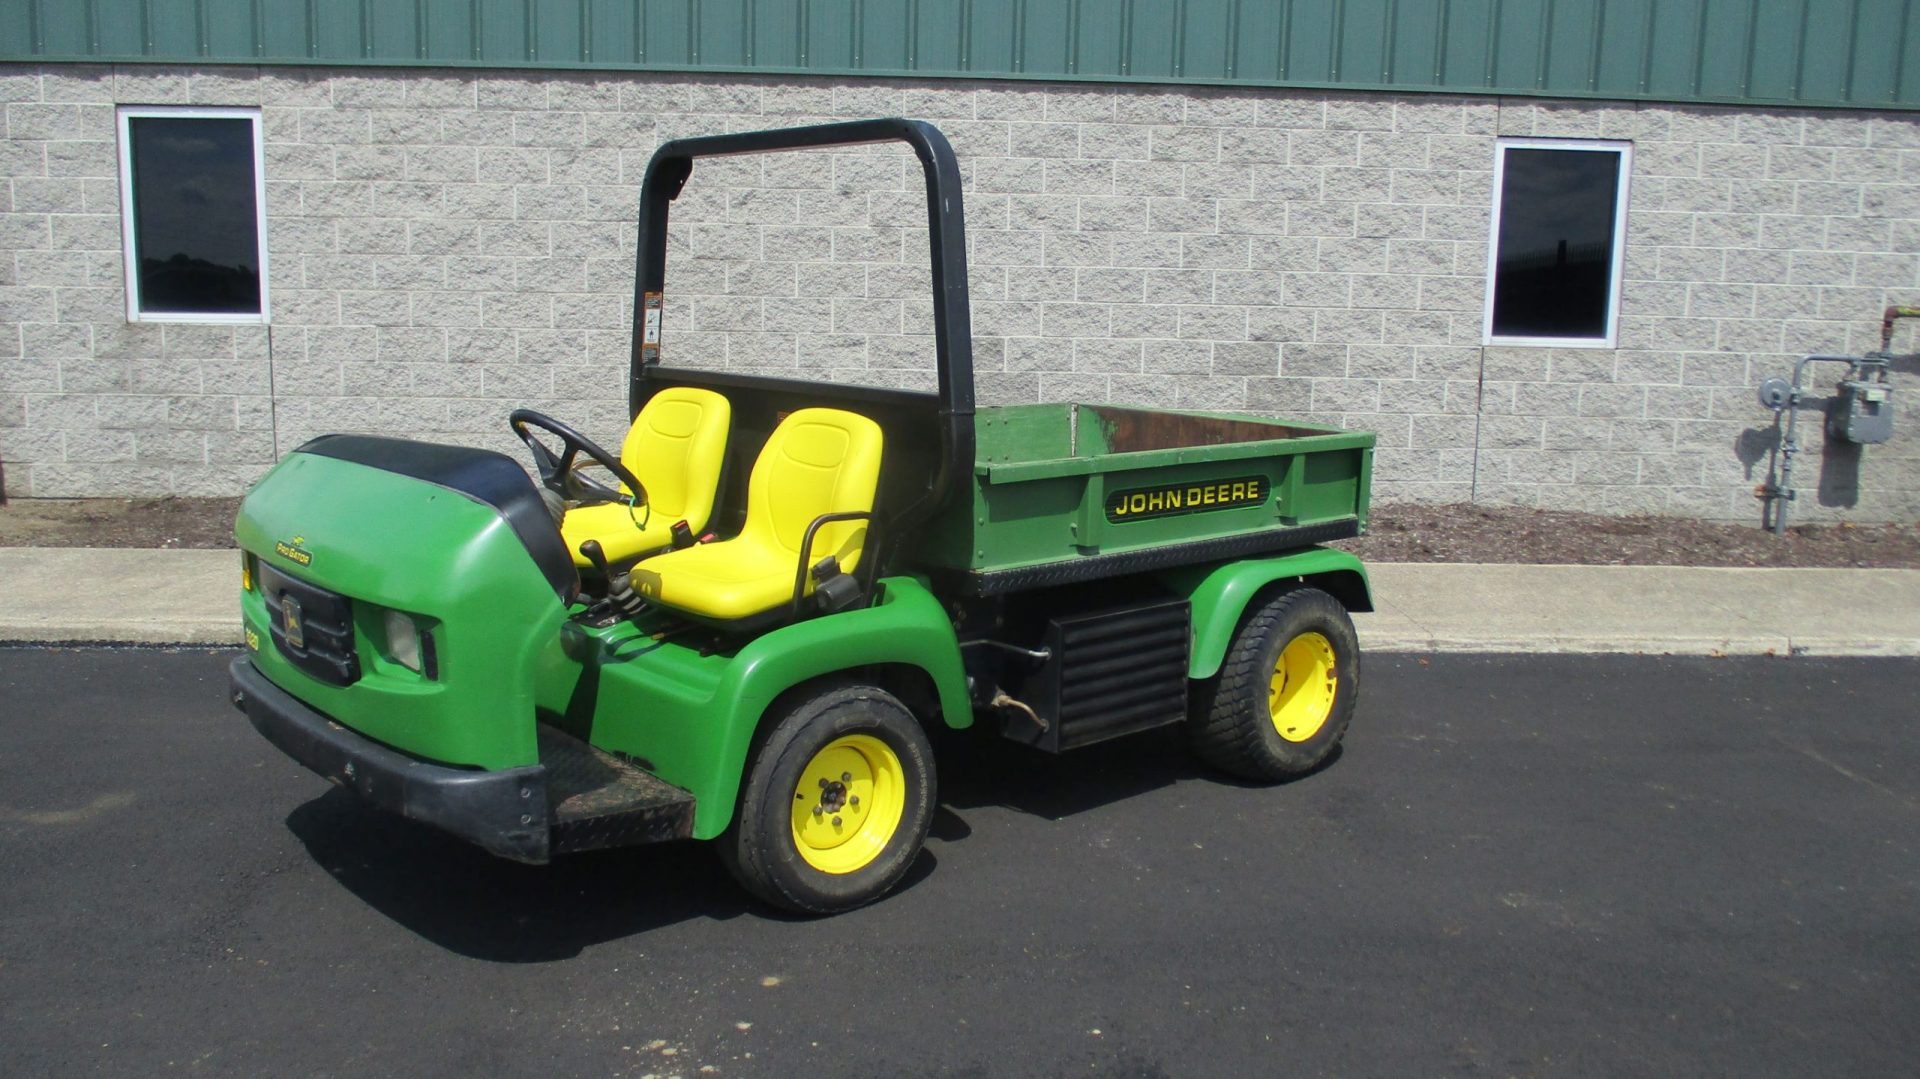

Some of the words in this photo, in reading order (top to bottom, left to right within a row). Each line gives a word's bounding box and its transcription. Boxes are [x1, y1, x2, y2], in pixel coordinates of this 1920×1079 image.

[1115, 490, 1182, 515] JOHN
[1187, 481, 1259, 506] DEERE
[276, 542, 290, 556] PRO
[289, 547, 309, 564] GATOR
